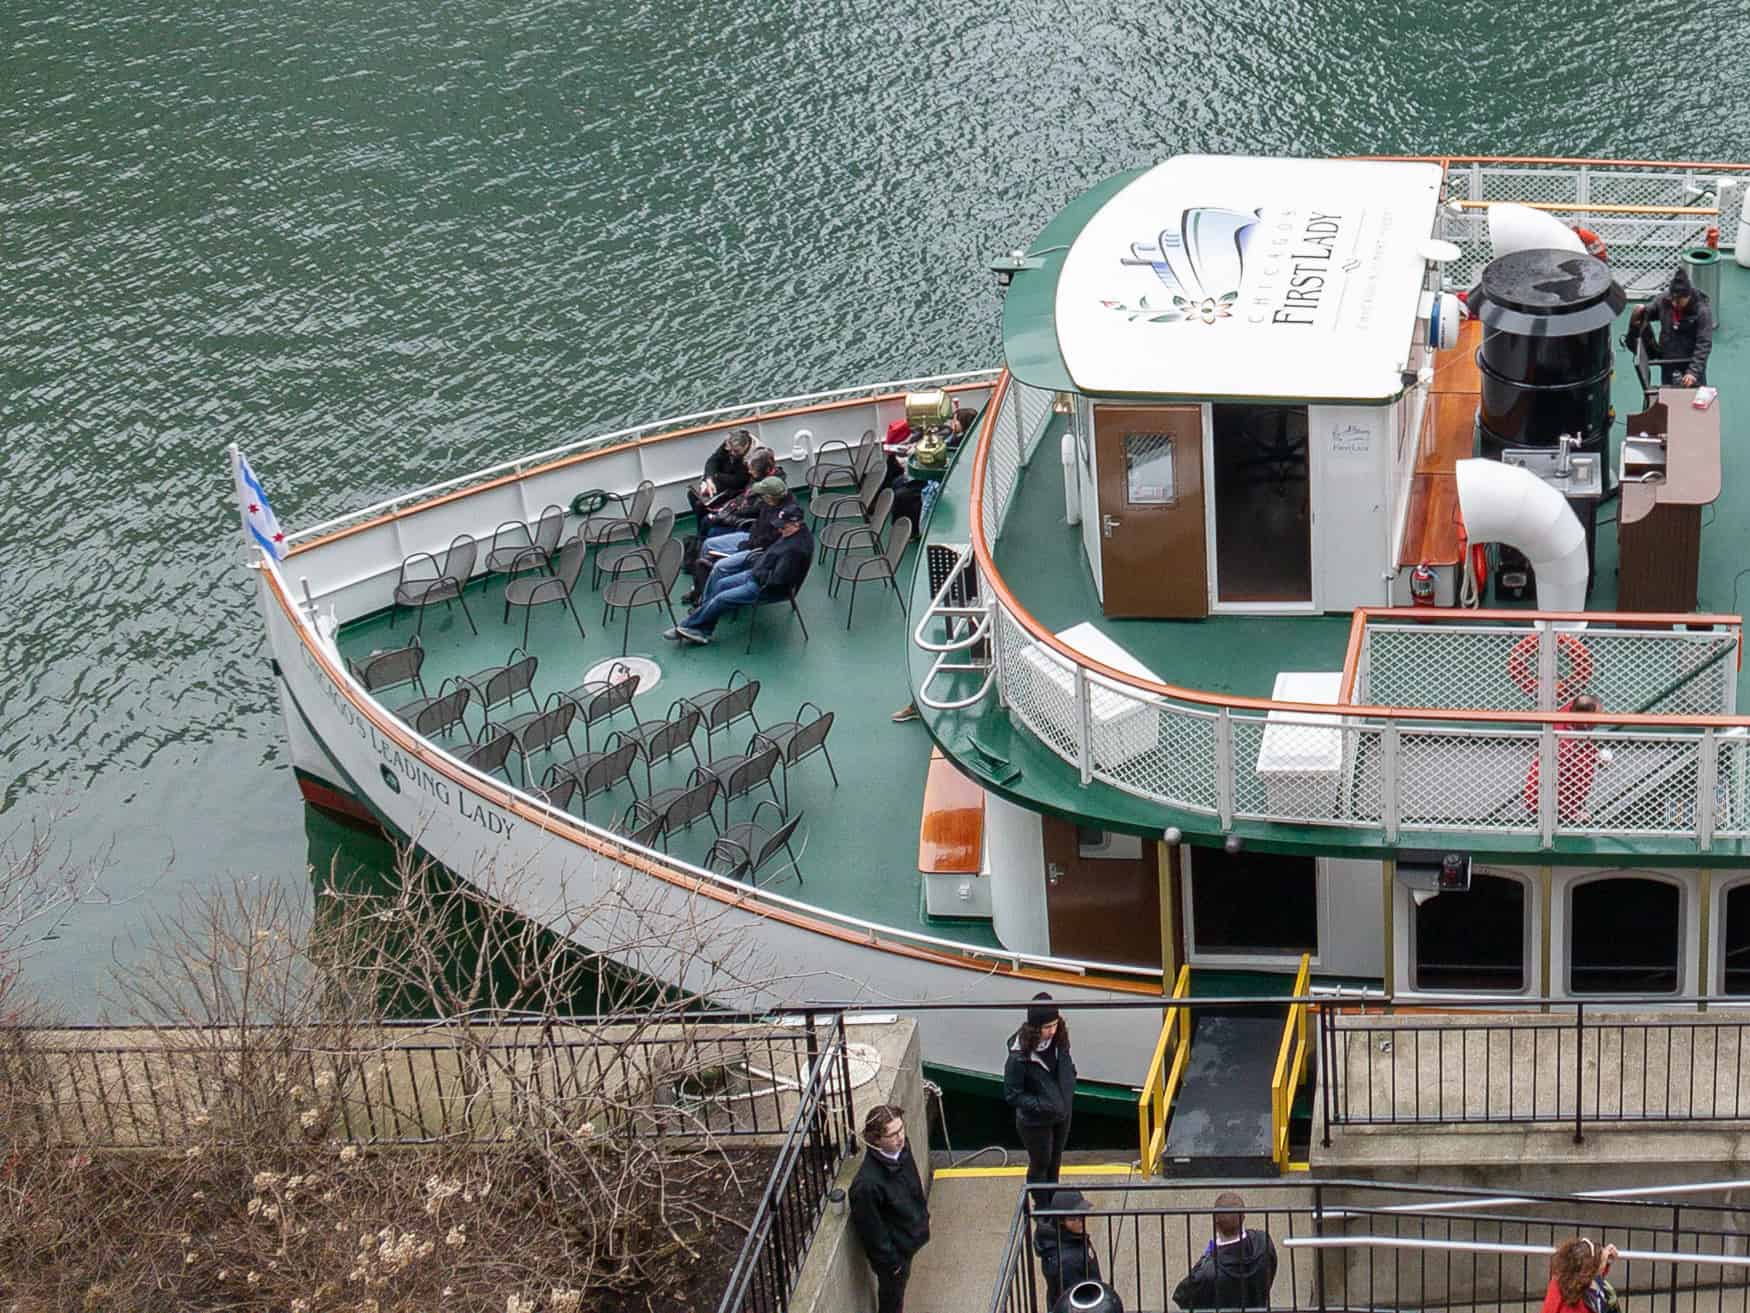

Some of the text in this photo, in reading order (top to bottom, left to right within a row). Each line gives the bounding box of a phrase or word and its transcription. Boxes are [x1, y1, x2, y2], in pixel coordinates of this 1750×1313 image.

[1248, 208, 1297, 325] CHICAGOS
[1272, 211, 1342, 325] FIRST LADY
[370, 726, 450, 805] LEADING
[458, 790, 515, 840] LADY
